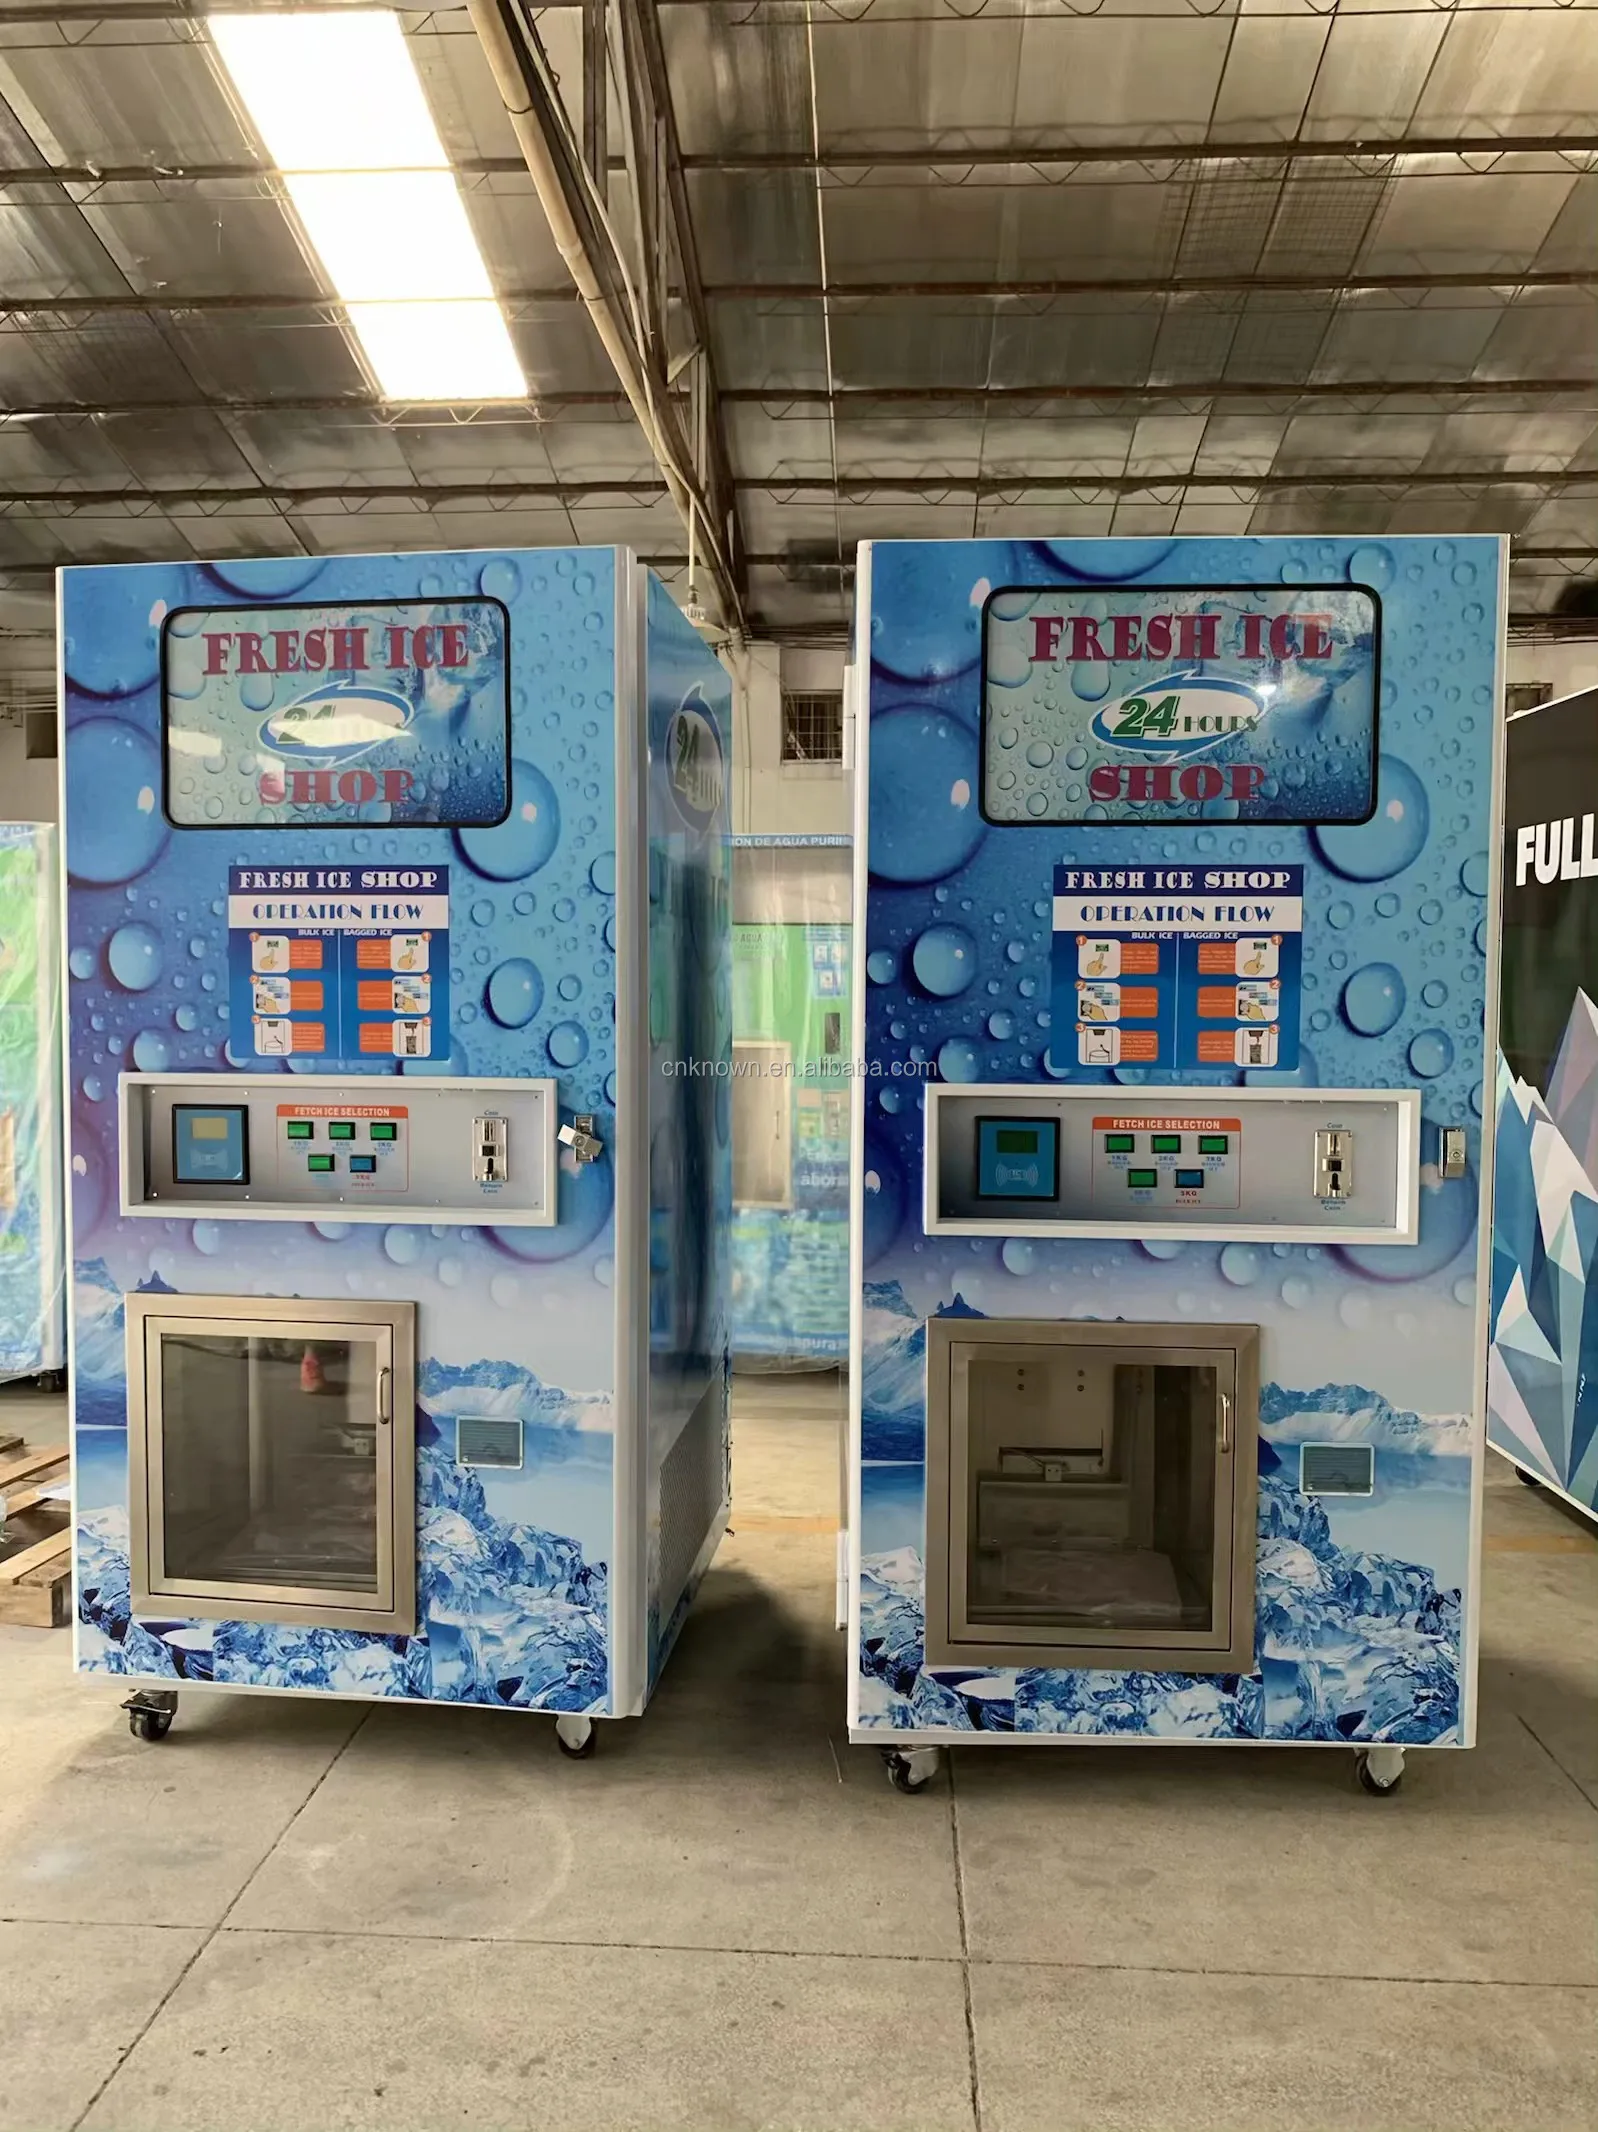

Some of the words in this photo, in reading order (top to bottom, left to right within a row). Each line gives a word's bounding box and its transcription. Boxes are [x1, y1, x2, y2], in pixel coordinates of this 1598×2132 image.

[1029, 614, 1221, 662] FRESH
[1238, 613, 1334, 660] ICE
[202, 627, 370, 676] FRESH
[385, 625, 469, 669] ICE
[1111, 695, 1181, 738] 24
[1184, 715, 1258, 733] HOURS
[260, 769, 414, 805] SHOP
[1088, 764, 1265, 802] SHOP
[755, 837, 770, 846] DE
[773, 837, 809, 846] AGUA
[1515, 813, 1598, 887] FULL
[239, 872, 309, 889] FRESH
[316, 872, 351, 889] ICE
[361, 871, 437, 889] SHOP
[1065, 872, 1145, 889] FRESH
[1153, 872, 1193, 889] ICE
[1204, 871, 1290, 889] SHOP
[252, 903, 362, 920] OPERATION
[371, 903, 423, 920] FLOW
[1080, 905, 1205, 922] OPERATION
[1214, 905, 1274, 922] FLOW
[298, 928, 320, 936] BULK
[322, 928, 335, 936] ICE
[343, 928, 377, 936] BAGGED
[379, 928, 392, 936] ICE
[1131, 931, 1156, 939] BULK
[1158, 931, 1173, 939] ICE
[1183, 931, 1221, 940] BAGGED
[1223, 931, 1238, 940] ICE
[295, 1107, 323, 1115] FETCH
[324, 1107, 340, 1116] ICE
[341, 1107, 390, 1117] SELECTION
[1113, 1120, 1144, 1129] FETCH
[1147, 1120, 1163, 1129] ICE
[1165, 1120, 1220, 1129] SELECTION
